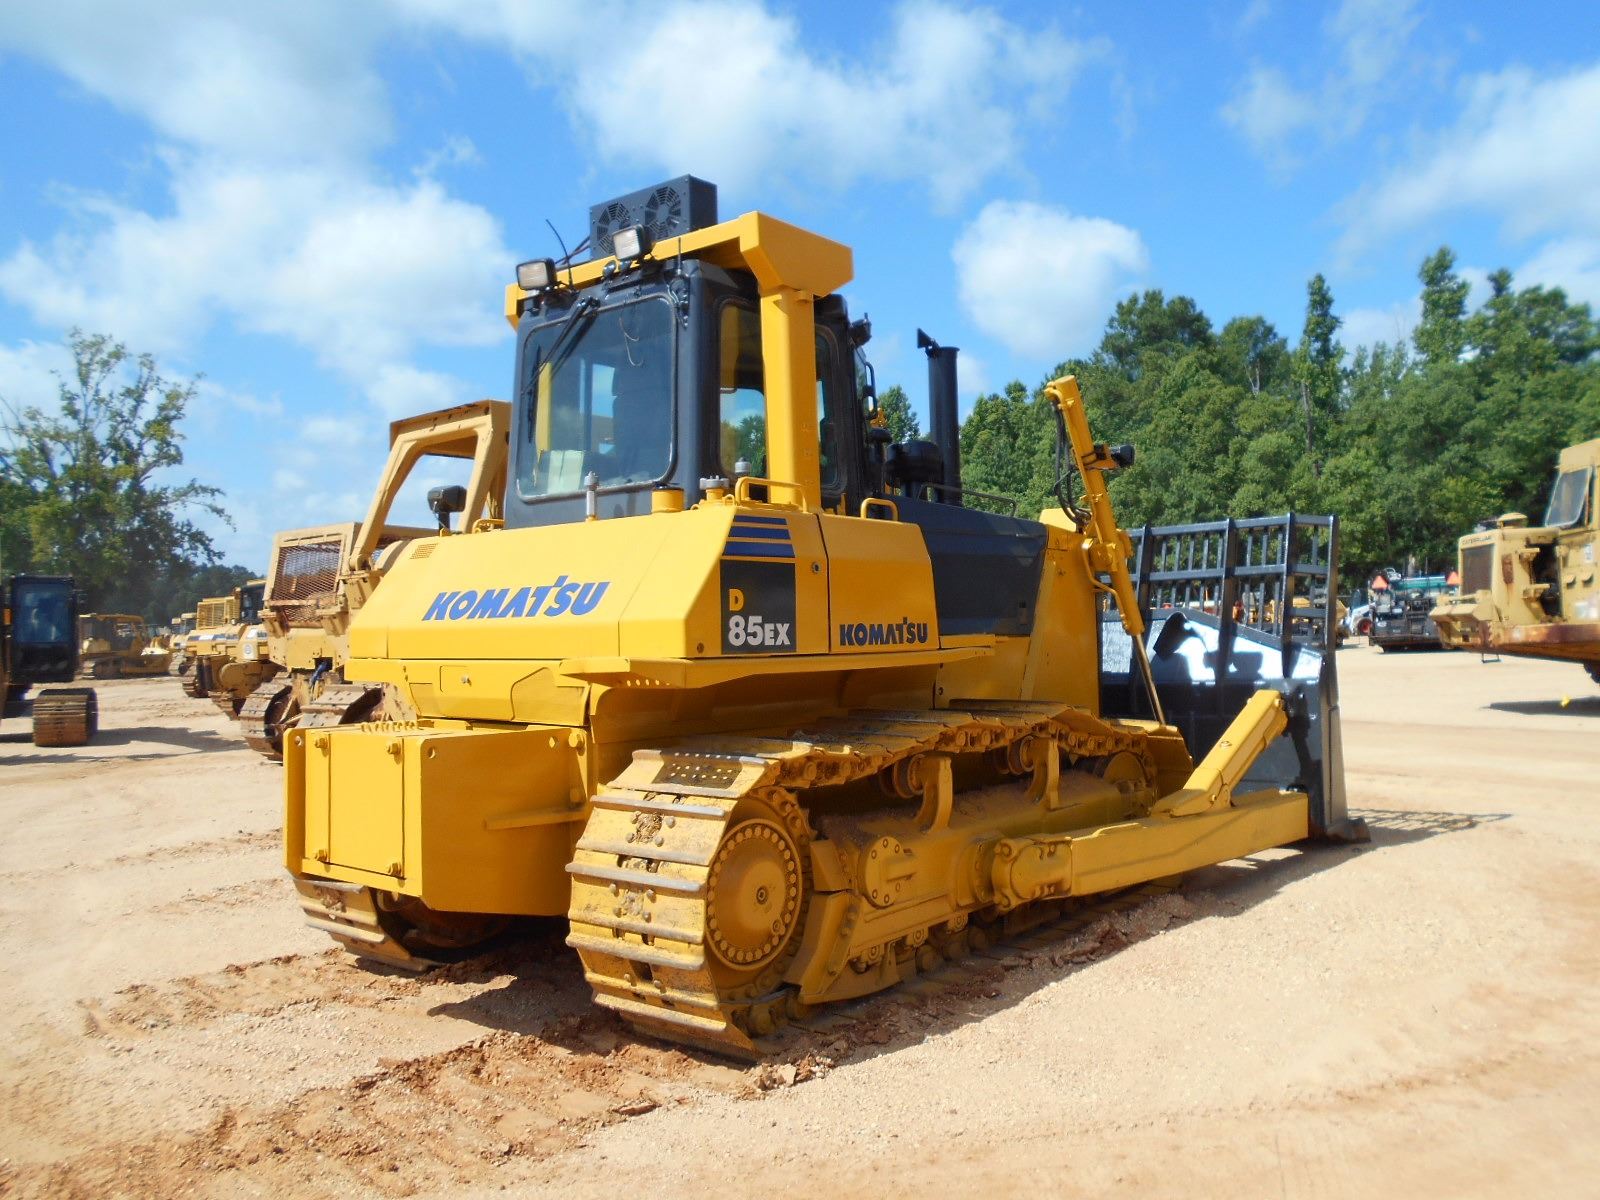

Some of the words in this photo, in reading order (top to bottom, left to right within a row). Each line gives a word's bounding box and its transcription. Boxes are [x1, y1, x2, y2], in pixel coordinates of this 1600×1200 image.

[421, 575, 610, 621] KOMATSU
[729, 588, 744, 611] D
[728, 615, 791, 646] 85EX
[839, 616, 928, 646] KOMATSU
